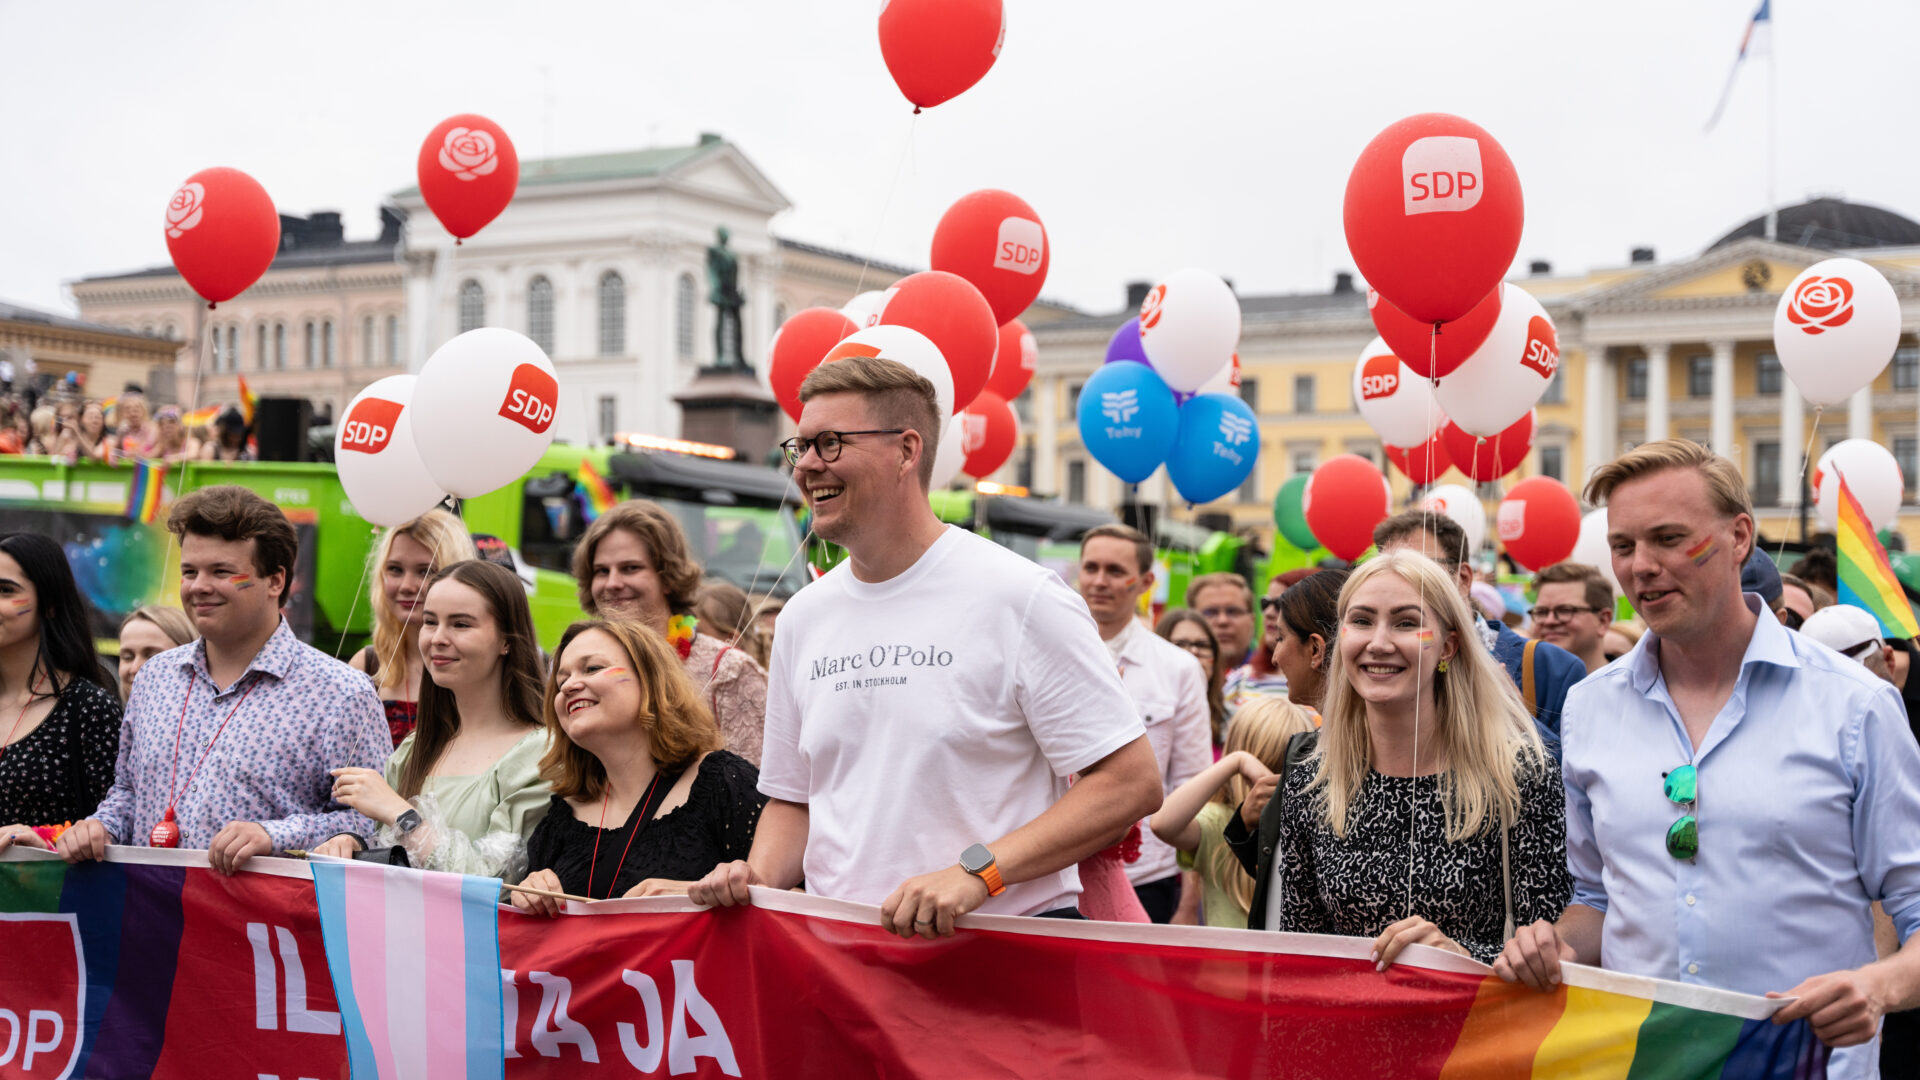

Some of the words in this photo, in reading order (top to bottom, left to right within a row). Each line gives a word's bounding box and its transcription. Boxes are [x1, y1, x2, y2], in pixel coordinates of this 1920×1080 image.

[1411, 171, 1477, 201] SDP
[1000, 241, 1040, 267] SDP
[1363, 374, 1397, 396] SDP
[507, 388, 553, 426] SDP
[344, 420, 387, 447] SDP
[809, 654, 863, 681] Marc
[869, 645, 953, 668] O'Polo
[835, 681, 850, 692] EST.
[852, 680, 862, 689] IN
[865, 676, 907, 688] STOCKHOLM
[616, 959, 742, 1078] JA
[0, 1008, 64, 1071] DP
